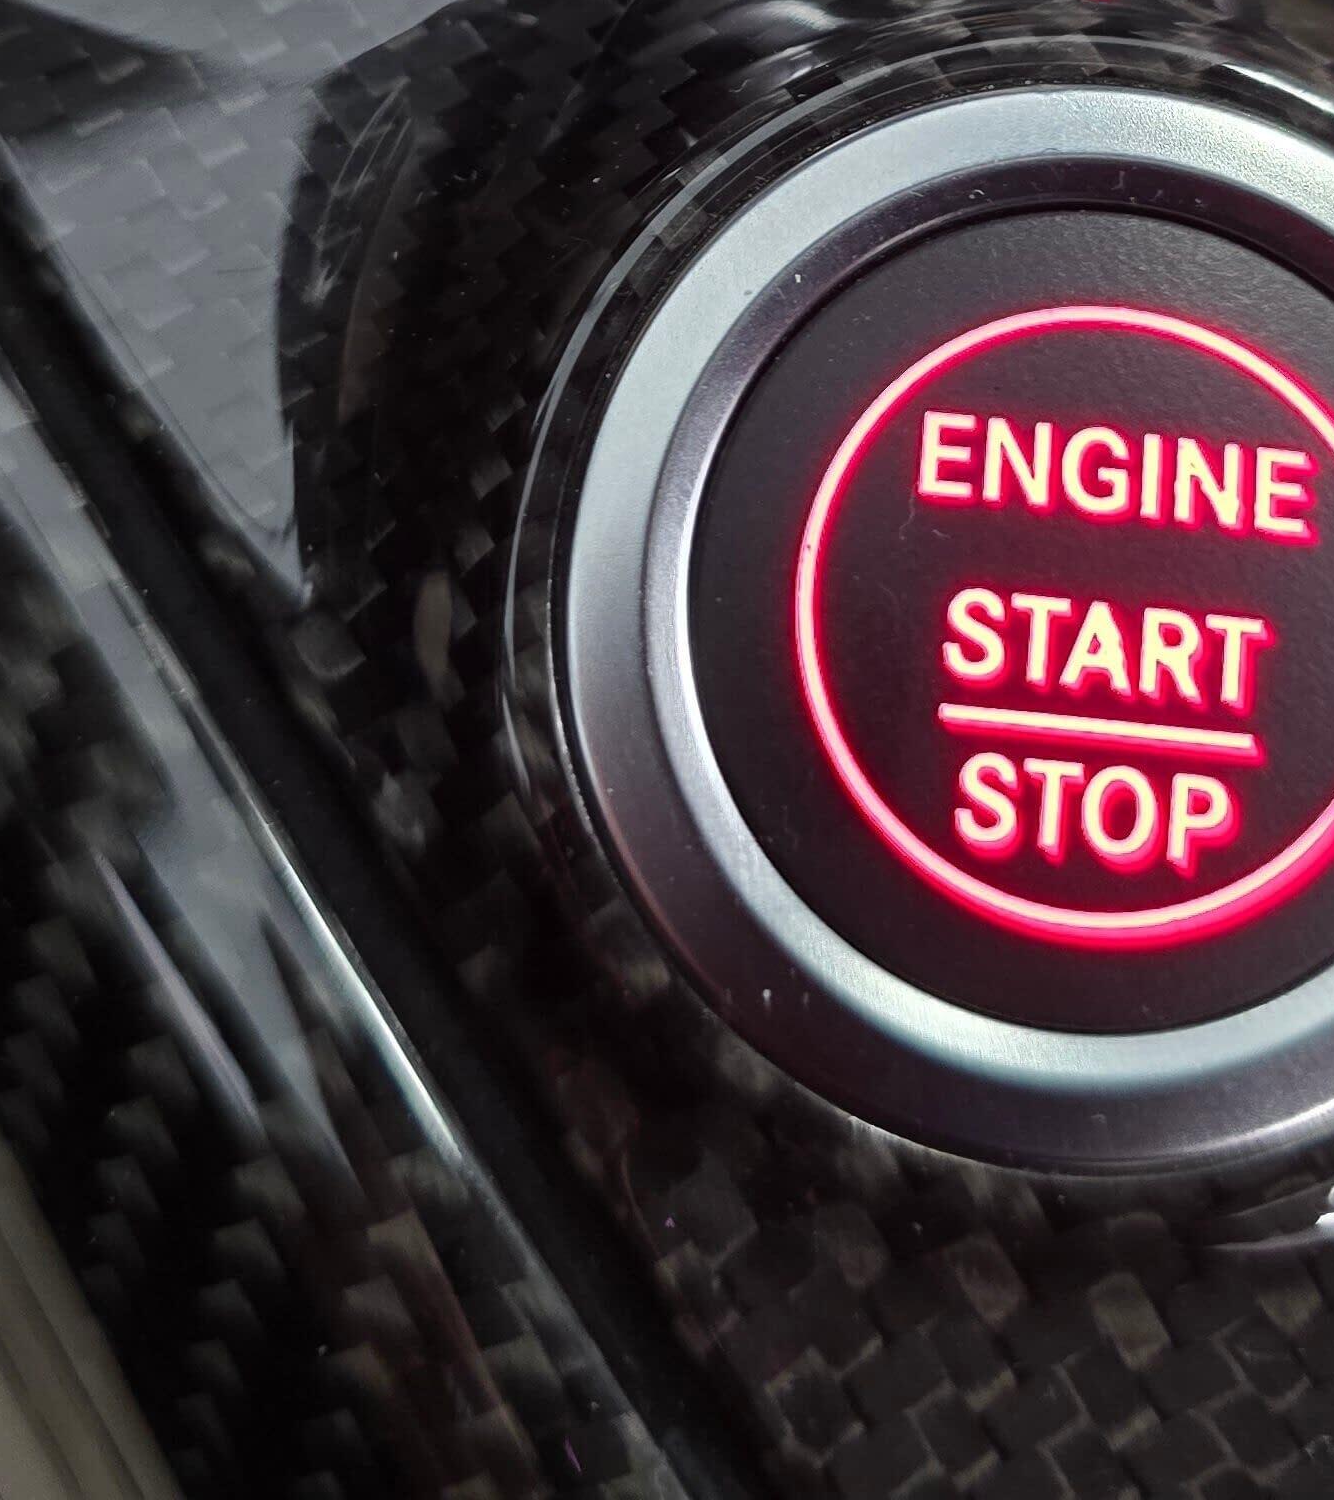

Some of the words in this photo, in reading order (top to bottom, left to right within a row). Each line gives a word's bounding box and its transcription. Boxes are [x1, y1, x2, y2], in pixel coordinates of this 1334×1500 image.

[917, 410, 1315, 540] ENGINE
[942, 587, 1269, 708] START
[954, 752, 1235, 870] STOP
